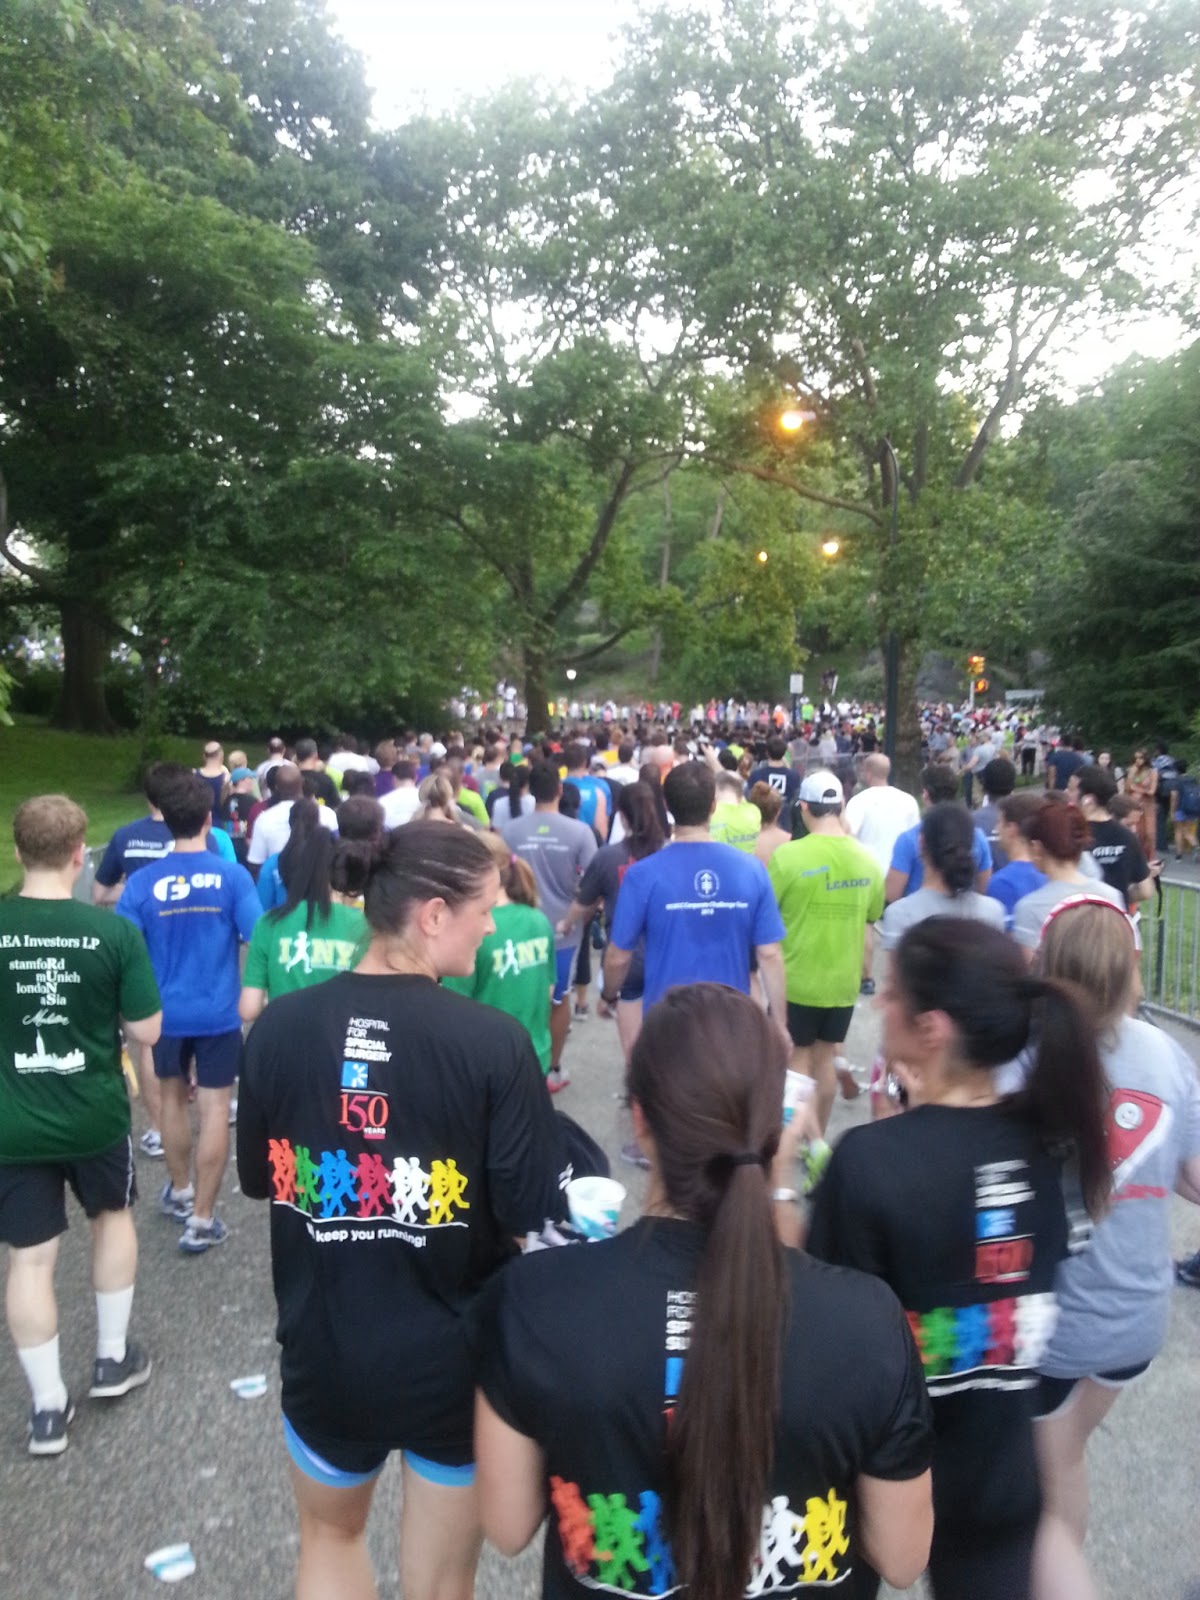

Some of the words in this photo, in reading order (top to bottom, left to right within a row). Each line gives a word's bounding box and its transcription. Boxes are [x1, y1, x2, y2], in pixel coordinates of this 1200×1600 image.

[23, 935, 80, 948] Investors
[82, 936, 100, 950] LP
[9, 957, 65, 970] stamfoRd
[36, 970, 81, 983] mUnich
[16, 982, 58, 994] londoN
[40, 993, 67, 1006] aSia
[349, 1017, 390, 1031] HOSPITAL
[346, 1026, 368, 1038] FOR
[345, 1036, 387, 1051] SPECIAL
[343, 1047, 392, 1062] SURGERY
[339, 1093, 389, 1132] 150
[315, 1229, 348, 1243] keep
[351, 1229, 375, 1241] you
[378, 1228, 427, 1248] running!
